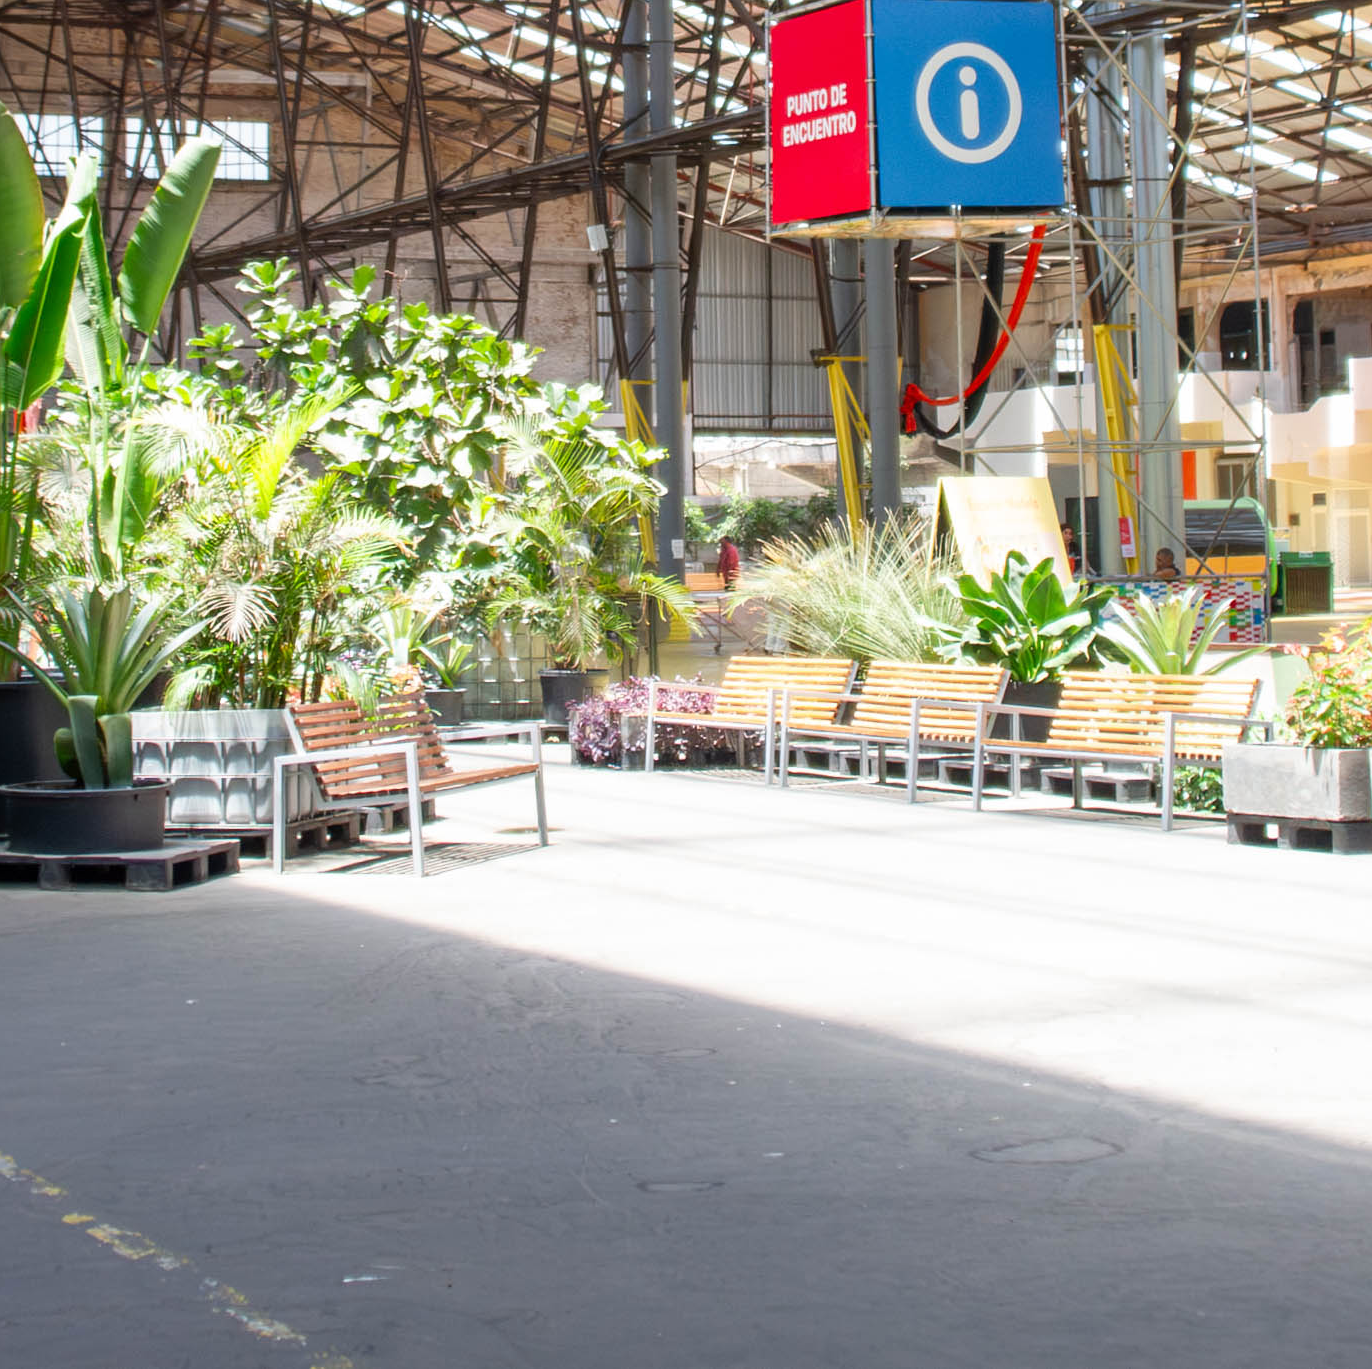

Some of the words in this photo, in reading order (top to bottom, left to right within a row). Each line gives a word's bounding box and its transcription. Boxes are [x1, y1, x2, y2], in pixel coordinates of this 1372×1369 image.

[786, 87, 828, 118] PUNTO
[830, 82, 848, 108] DE
[782, 110, 857, 148] ENCUENTRO
